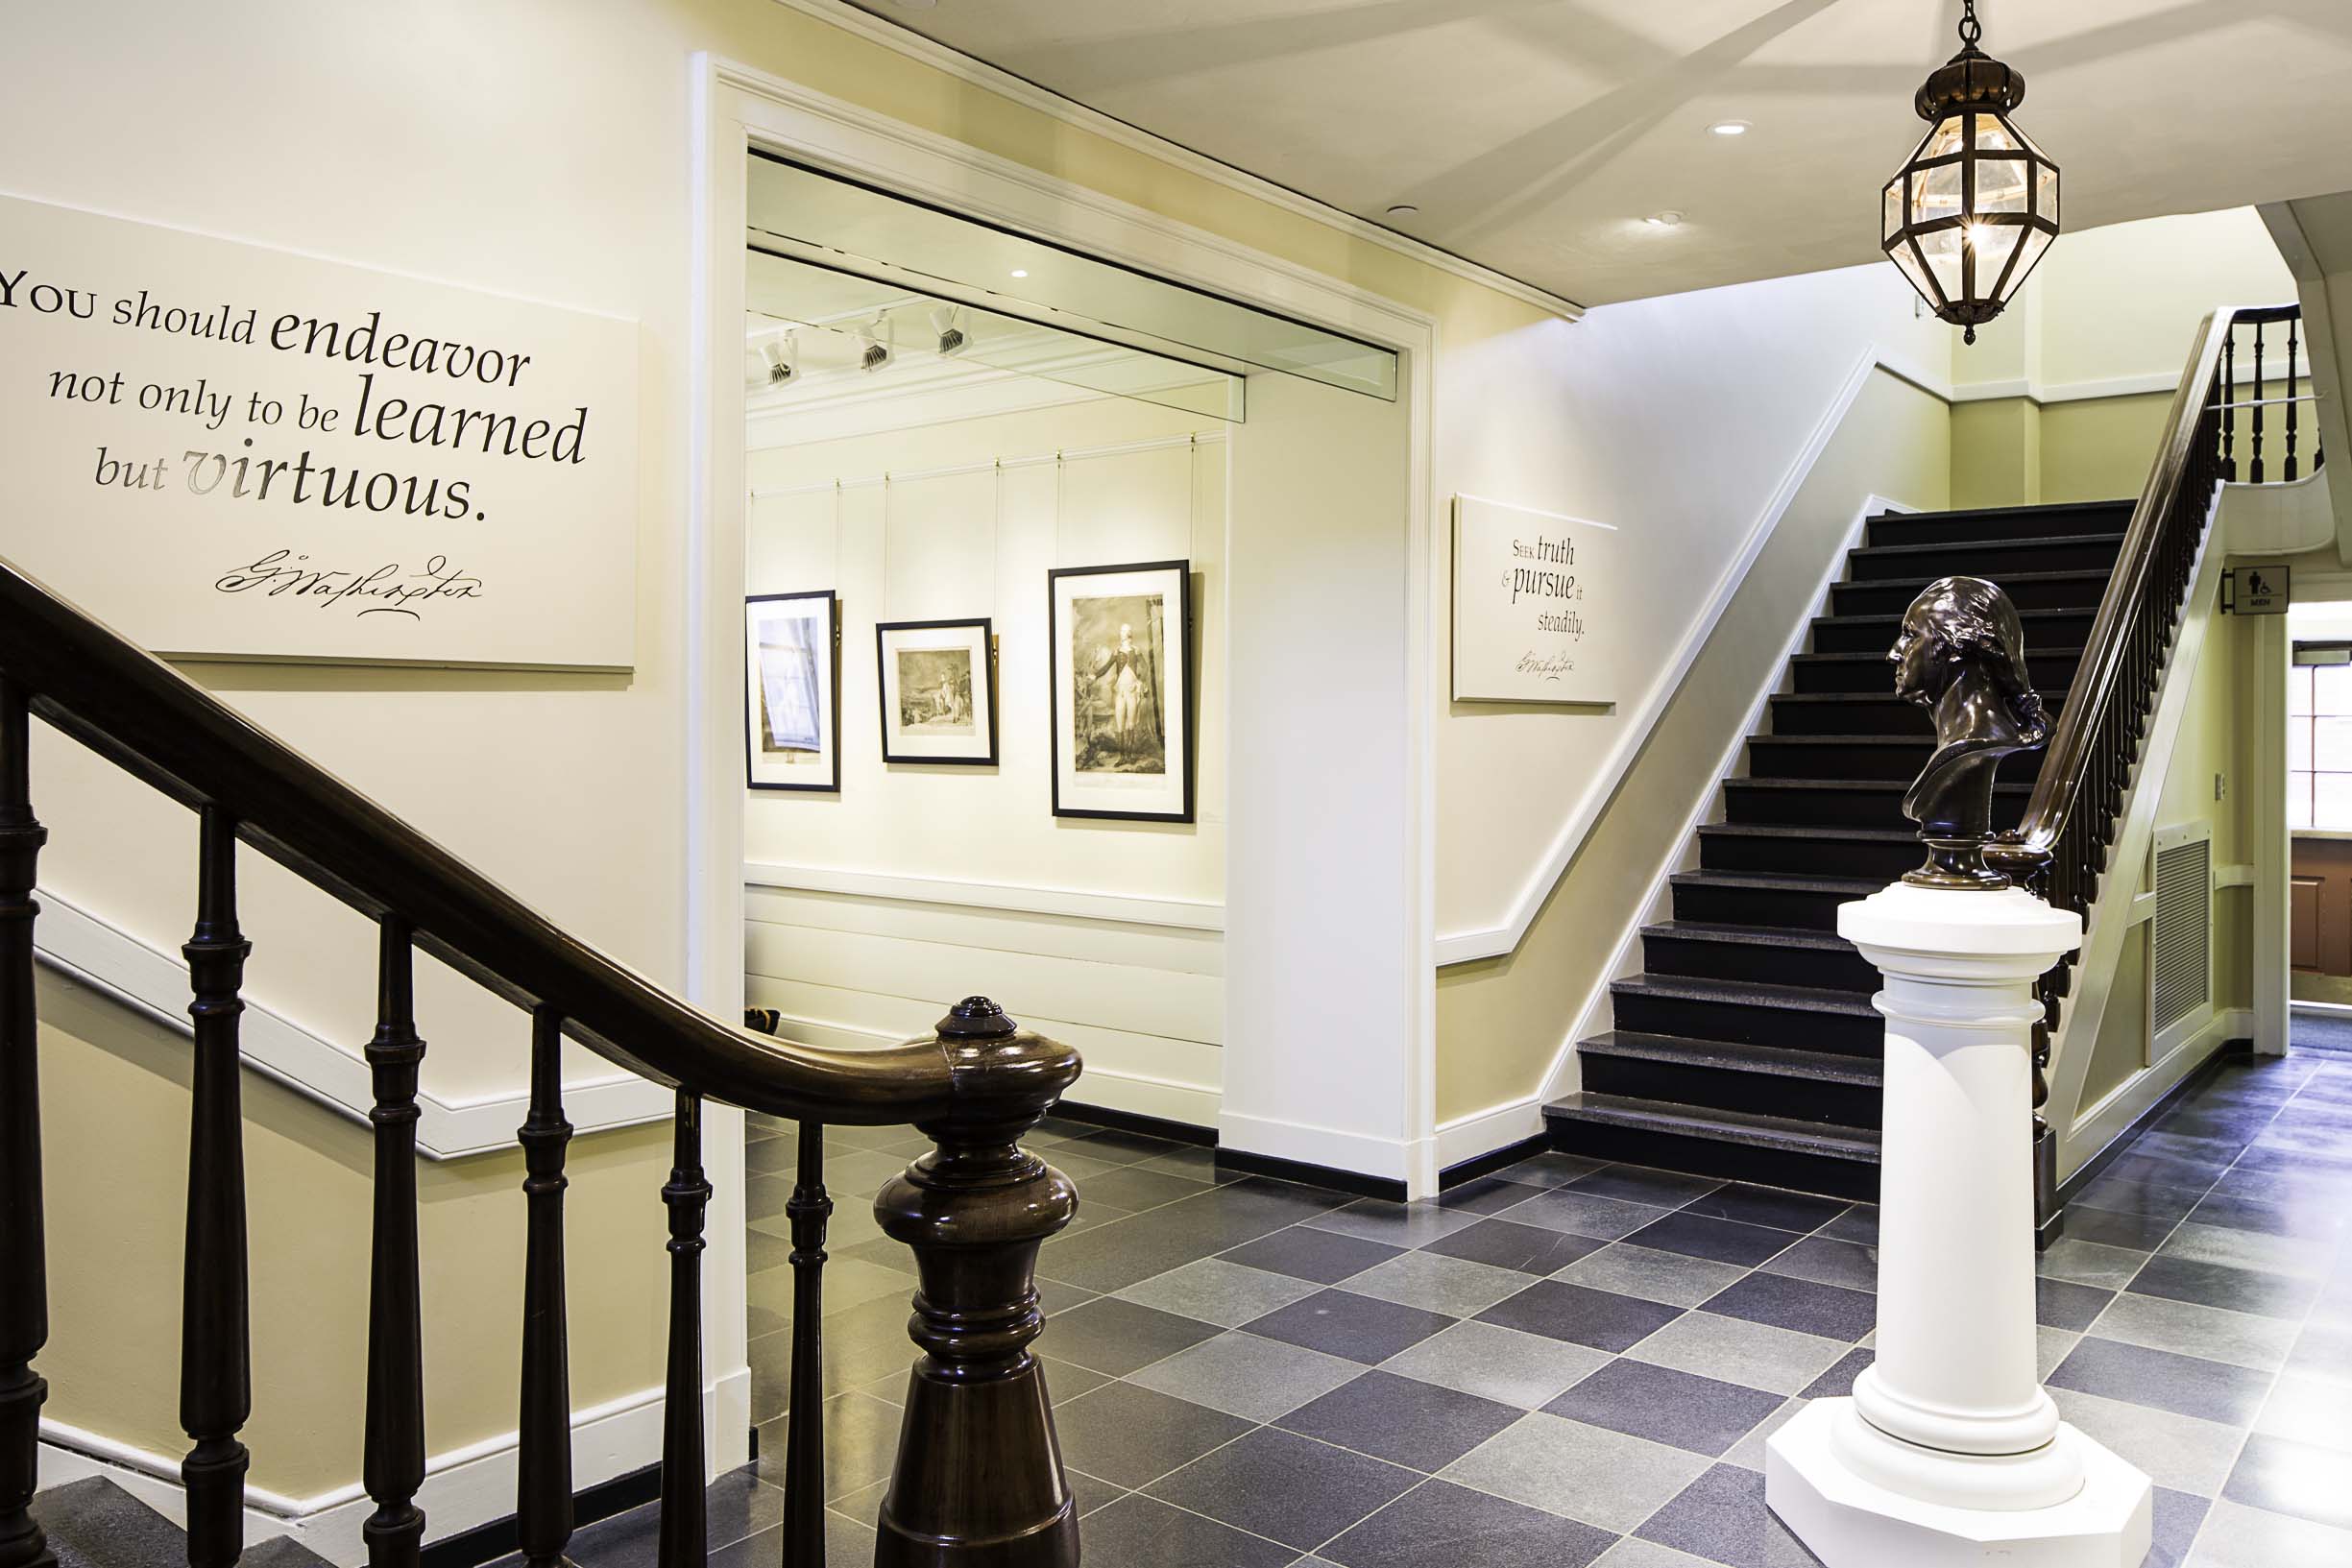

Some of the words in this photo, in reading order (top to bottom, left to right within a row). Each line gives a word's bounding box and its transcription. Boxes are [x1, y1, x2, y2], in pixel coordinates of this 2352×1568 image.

[112, 290, 257, 345] should
[270, 311, 531, 387] endeavor
[49, 370, 126, 404] not
[138, 378, 232, 430] only
[247, 391, 283, 425] to
[298, 394, 339, 432] be
[354, 374, 588, 465] learned
[95, 446, 169, 491] but
[182, 438, 485, 521] virtuous.
[1537, 535, 1575, 566] truth
[1512, 567, 1575, 605] pursue
[1576, 585, 1584, 600] it
[2250, 598, 2271, 607] MEN
[1538, 610, 1585, 642] steadily.
